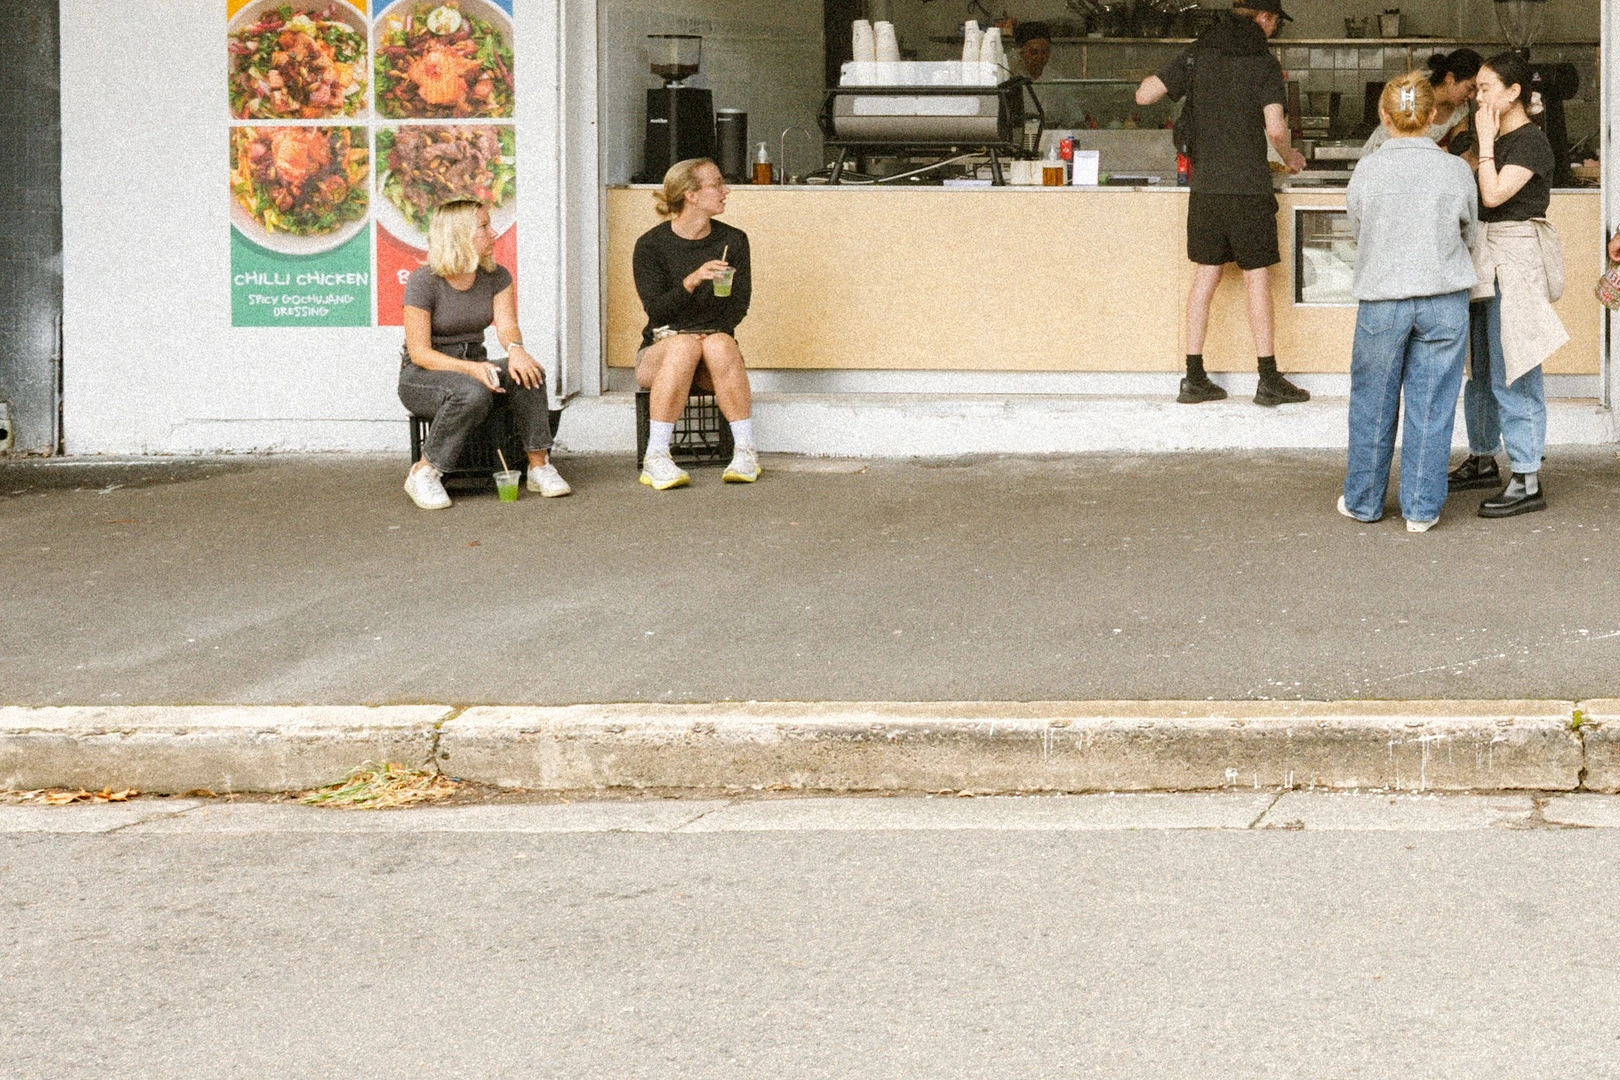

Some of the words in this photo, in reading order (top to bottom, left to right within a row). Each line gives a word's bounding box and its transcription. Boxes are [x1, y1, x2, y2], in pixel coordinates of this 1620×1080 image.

[234, 270, 290, 286] CHILLI
[296, 271, 369, 286] CHICKEN
[248, 294, 279, 305] SPICY
[281, 294, 355, 305] GOCHUJANG
[273, 307, 329, 317] DRESSING
